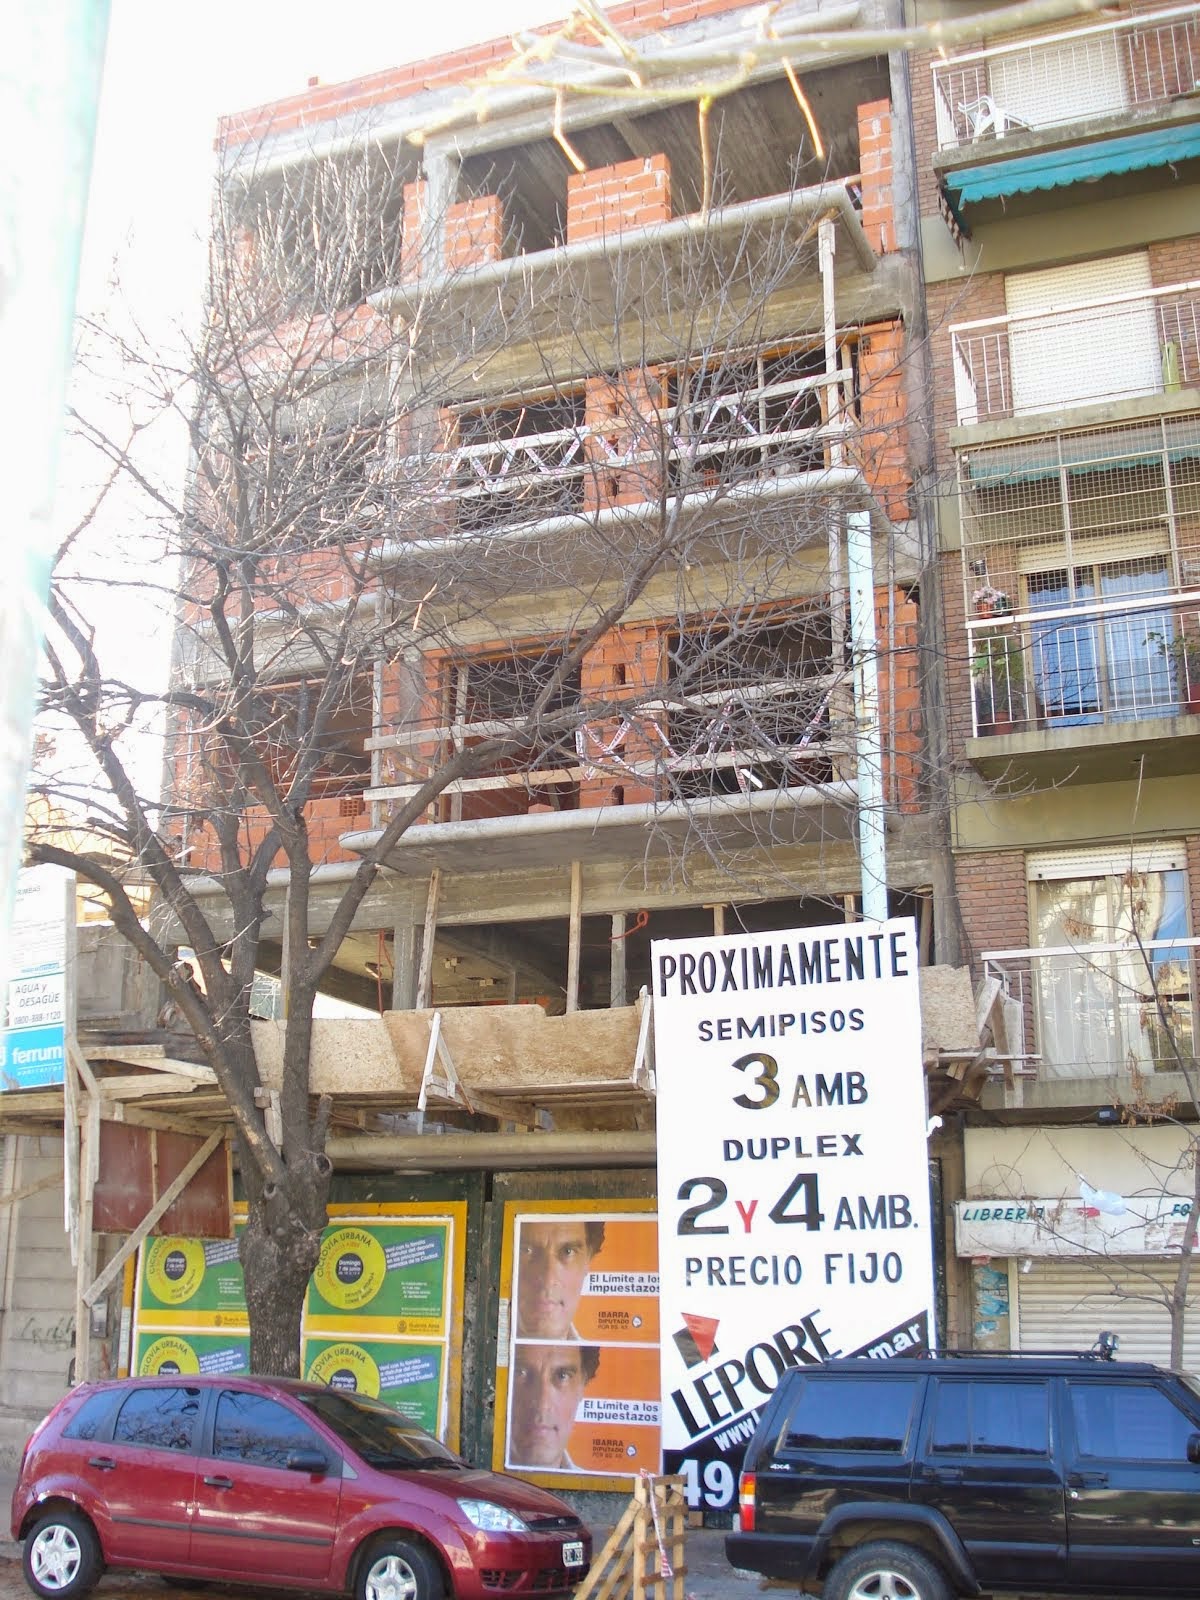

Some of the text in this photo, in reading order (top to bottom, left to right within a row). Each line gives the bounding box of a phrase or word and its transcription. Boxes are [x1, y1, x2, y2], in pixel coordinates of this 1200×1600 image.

[660, 932, 908, 996] PROXIMAMENTE
[15, 983, 39, 994] AGUA
[699, 1009, 864, 1041] SEMIPISOS
[12, 1045, 62, 1064] ferrum
[732, 1053, 868, 1109] 3 AMB
[724, 1134, 863, 1161] DUPLEX
[678, 1173, 918, 1235] 2 Y 4 AMB.
[1171, 1203, 1193, 1216] FO
[963, 1207, 1044, 1221] LIBRERA
[340, 1232, 371, 1247] URBANA
[687, 1252, 902, 1285] PRECIO FIJO
[590, 1274, 599, 1283] El
[603, 1274, 635, 1283] Límite
[335, 1348, 366, 1363] URBANA
[671, 1309, 842, 1439] LEPORE
[584, 1400, 593, 1409] El
[597, 1401, 629, 1411] Límite
[643, 1403, 659, 1412] los
[583, 1409, 658, 1422] impuestazos
[592, 1439, 624, 1447] IBARRA
[770, 1463, 791, 1471] 4x4
